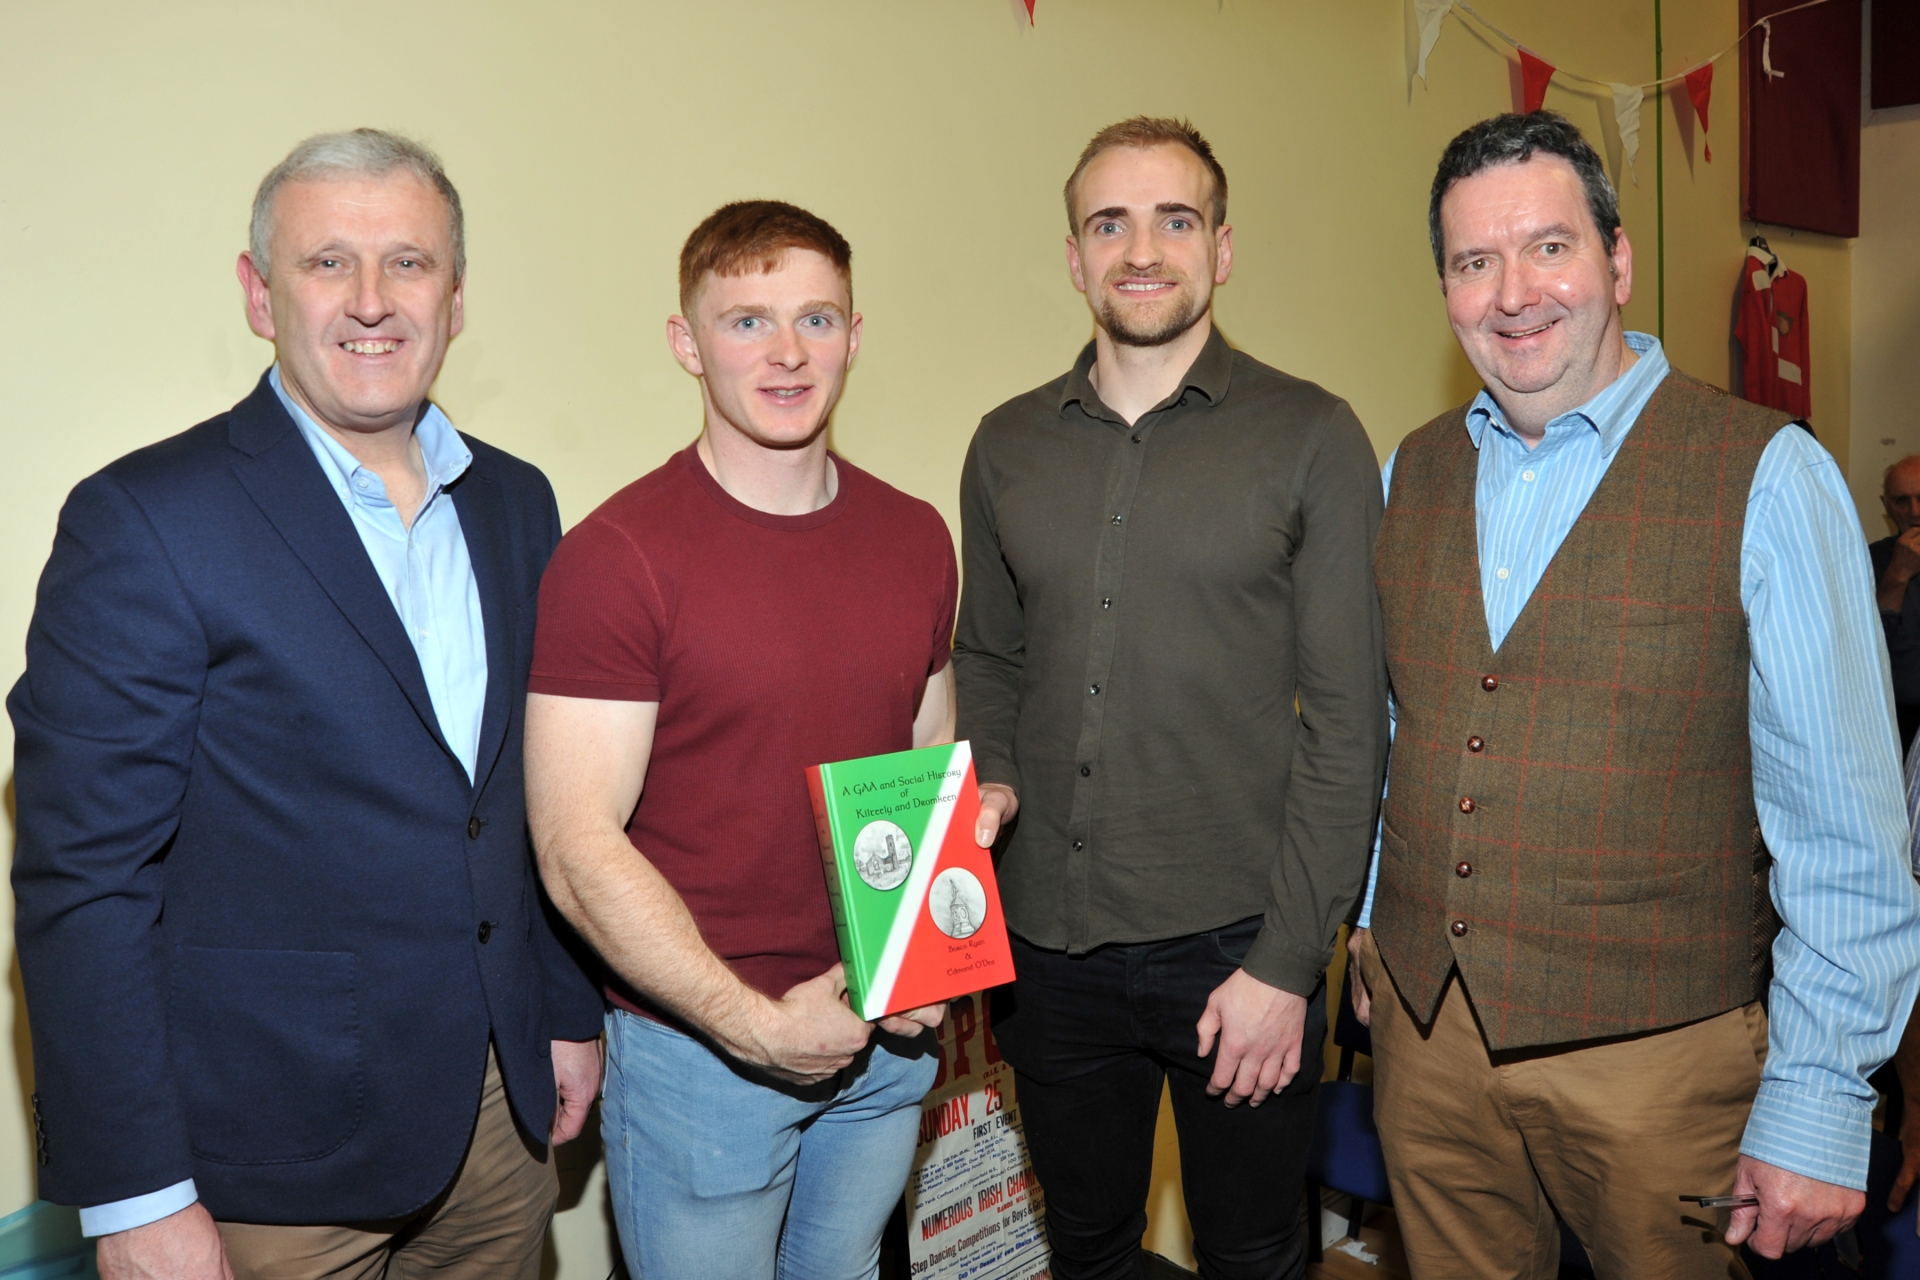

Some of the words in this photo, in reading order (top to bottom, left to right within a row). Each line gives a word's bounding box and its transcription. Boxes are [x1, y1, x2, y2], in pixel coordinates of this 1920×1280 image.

[842, 786, 851, 797] A
[853, 781, 878, 796] GAA
[880, 779, 896, 790] and
[897, 774, 925, 787] Social
[926, 769, 962, 782] History
[899, 788, 909, 798] of
[855, 806, 893, 819] Kilteely
[894, 801, 911, 812] and
[912, 794, 957, 809] Dromkeen
[947, 944, 968, 953] Bosco
[968, 939, 985, 948] Ryan
[964, 952, 973, 960] &
[946, 964, 974, 977] Edmond
[917, 1092, 975, 1149] SUNDAY,
[984, 1078, 1004, 1117] 25
[973, 1120, 992, 1141] FIRST
[996, 1108, 1017, 1129] EVENT
[1015, 1194, 1028, 1204] WILL
[921, 1196, 974, 1242] NUMEROUS
[977, 1182, 1003, 1213] IRISH
[910, 1259, 928, 1276] Step
[929, 1244, 957, 1267] Dancing
[957, 1222, 1001, 1252] Competitions
[1002, 1215, 1011, 1229] for
[1011, 1206, 1028, 1223] Boys
[1027, 1202, 1033, 1215] &
[1015, 1237, 1032, 1249] Choice
